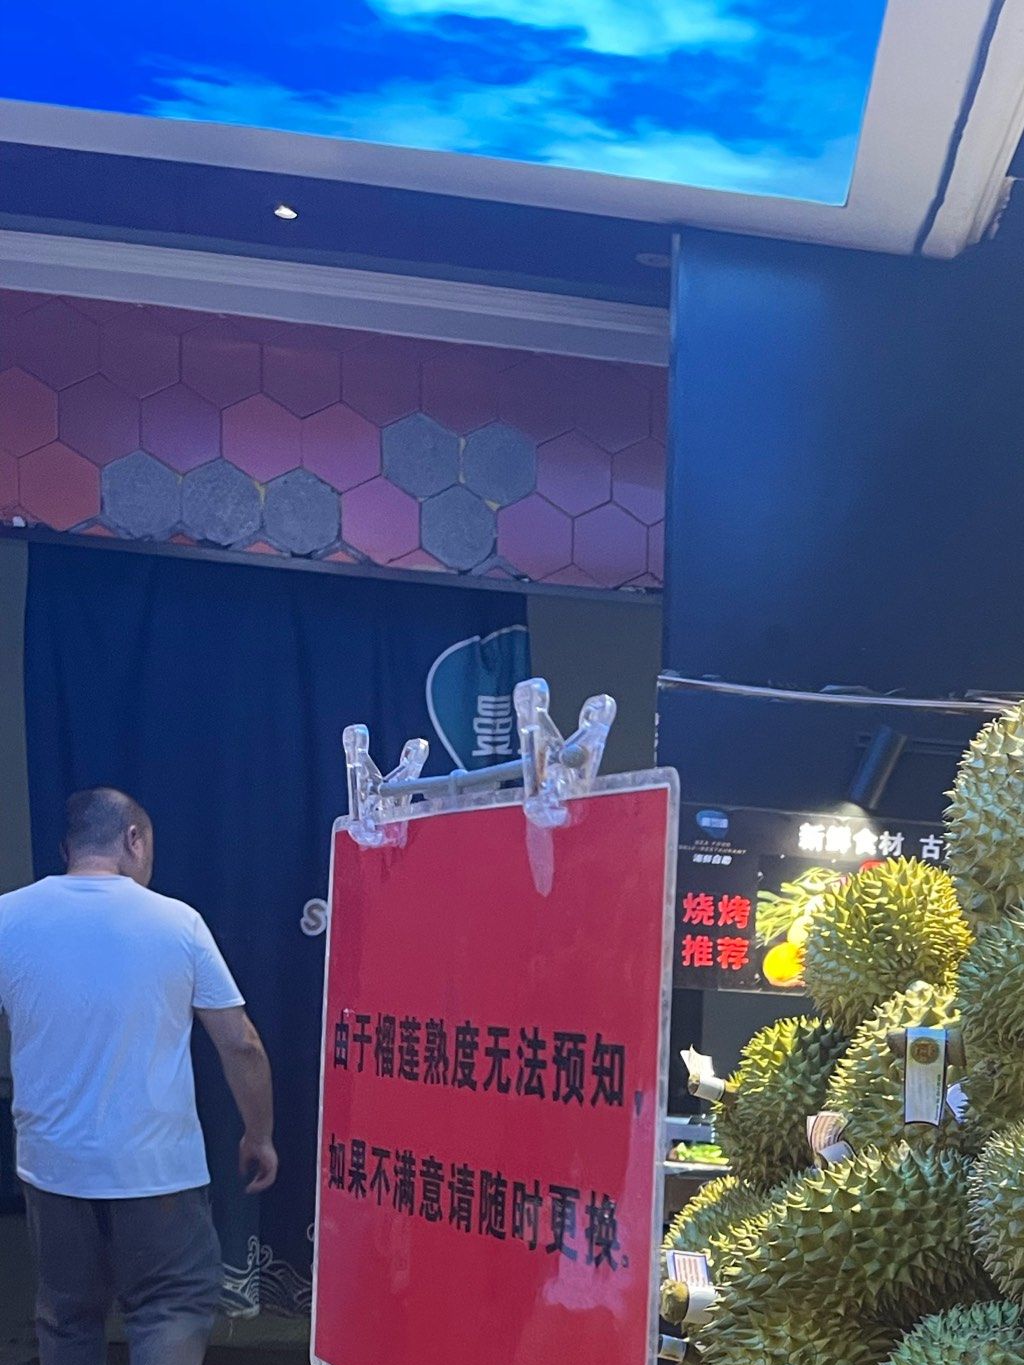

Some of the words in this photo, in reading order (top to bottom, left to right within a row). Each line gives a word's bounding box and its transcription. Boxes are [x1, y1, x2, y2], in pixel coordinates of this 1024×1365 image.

[919, 834, 950, 861] 古
[682, 892, 751, 930] 烧烤
[681, 934, 750, 970] 推荐
